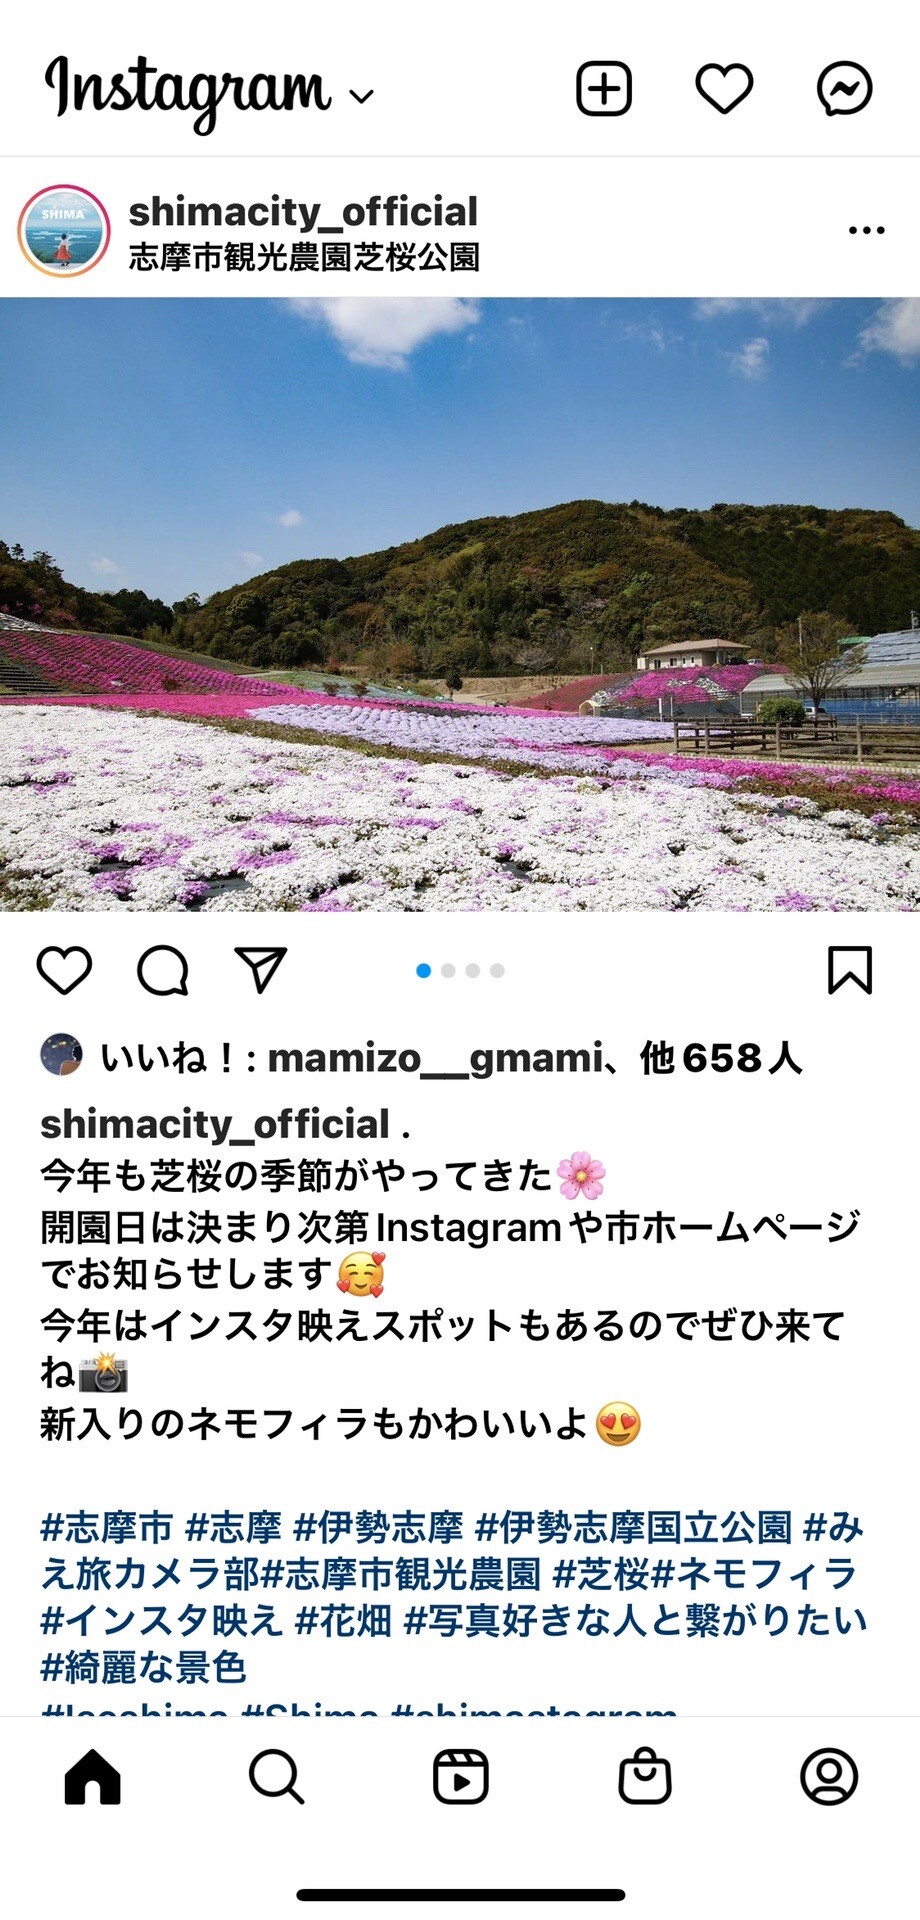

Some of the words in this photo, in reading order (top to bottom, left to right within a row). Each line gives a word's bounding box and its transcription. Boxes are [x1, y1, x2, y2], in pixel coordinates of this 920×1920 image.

[45, 56, 332, 136] Instagram
[41, 209, 85, 220] SHIMA
[129, 194, 477, 234] shimacity_official
[128, 242, 480, 273] 志摩市観光農園芝桜公園
[40, 1107, 389, 1147] shimacity_official
[40, 1158, 552, 1193] 今年も芝桜の季節がやってきた
[41, 1257, 331, 1291] でお知らせします
[40, 1307, 845, 1344] 今年はインスタ映えスポットもあるのでぜひ来て
[40, 1355, 76, 1389] ね
[40, 1406, 587, 1441] 新入りのネモフィラもかわいいよ
[40, 1510, 174, 1544] #志摩市
[184, 1510, 282, 1544] #志摩
[292, 1510, 464, 1544] #伊勢志摩
[474, 1510, 792, 1544] #伊勢志摩国立公園
[802, 1511, 864, 1544] #み
[40, 1603, 283, 1637] #インスタ映え
[294, 1603, 391, 1638] #花畑
[403, 1603, 867, 1638] #写真好きな人と繋がりたい
[40, 1650, 247, 1685] #綺麗な景色
